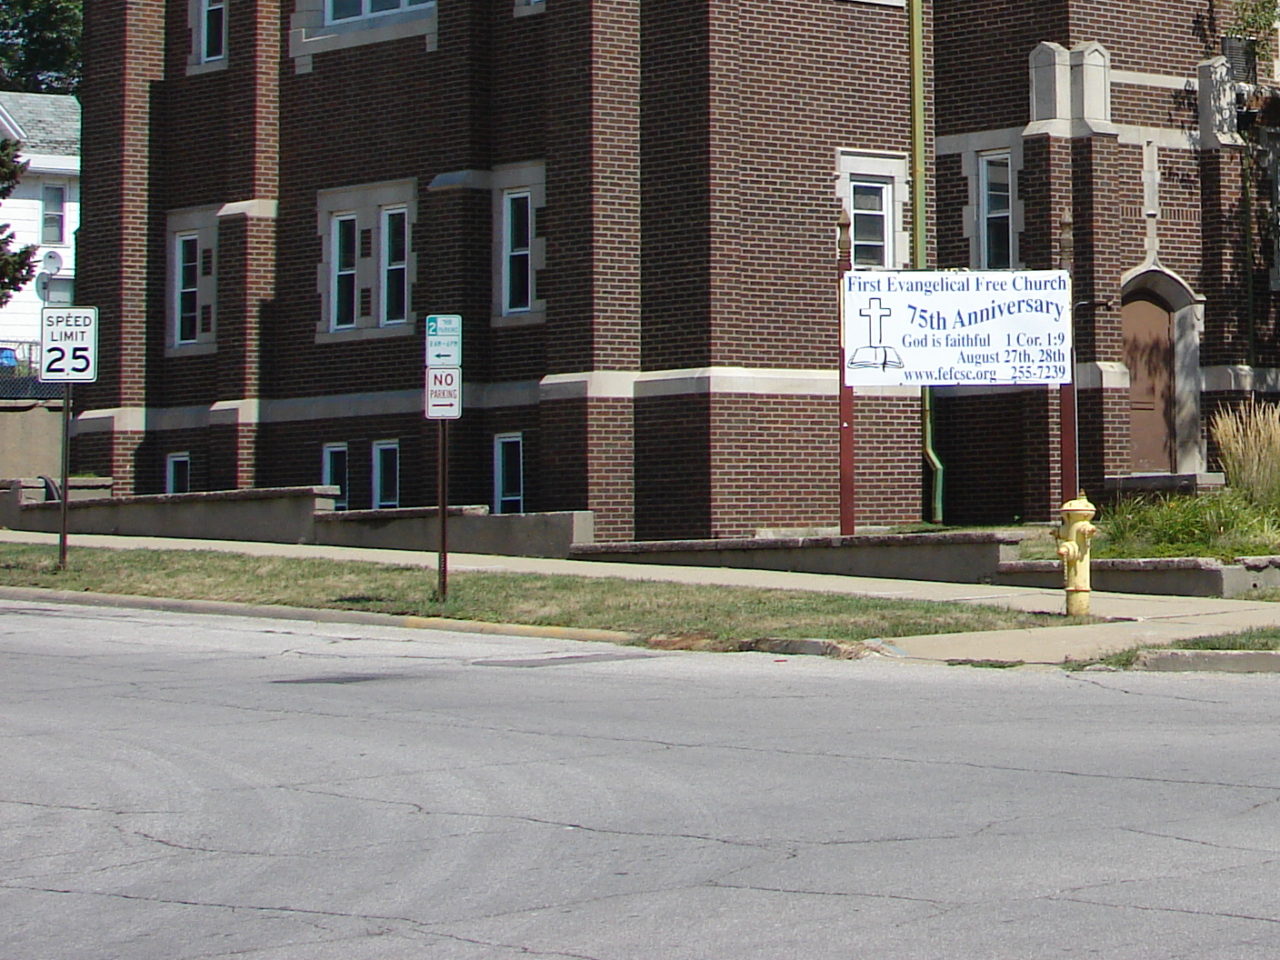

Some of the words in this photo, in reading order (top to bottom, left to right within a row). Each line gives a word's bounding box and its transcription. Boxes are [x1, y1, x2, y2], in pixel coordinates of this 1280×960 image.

[847, 276, 881, 292] First
[887, 276, 969, 295] Evangelical
[976, 276, 1007, 291] Free
[1012, 275, 1066, 291] Church
[46, 315, 92, 327] SPEED
[907, 304, 946, 330] 75th
[952, 297, 1064, 329] Anniversary
[428, 322, 436, 335] 2
[50, 331, 87, 342] LIMIT
[902, 334, 927, 348] God
[932, 334, 942, 348] is
[945, 333, 991, 348] faithful
[1006, 334, 1011, 346] 1
[1016, 333, 1042, 347] Cor.
[1047, 333, 1065, 346] 1:9
[46, 346, 91, 373] 25
[957, 351, 1000, 364] August
[1003, 349, 1035, 364] 27th,
[1038, 349, 1065, 363] 28th
[433, 373, 454, 386] NO
[904, 366, 997, 381] www.fefcsc.org
[1011, 365, 1066, 380] 255-7239
[430, 389, 457, 399] PARKING
